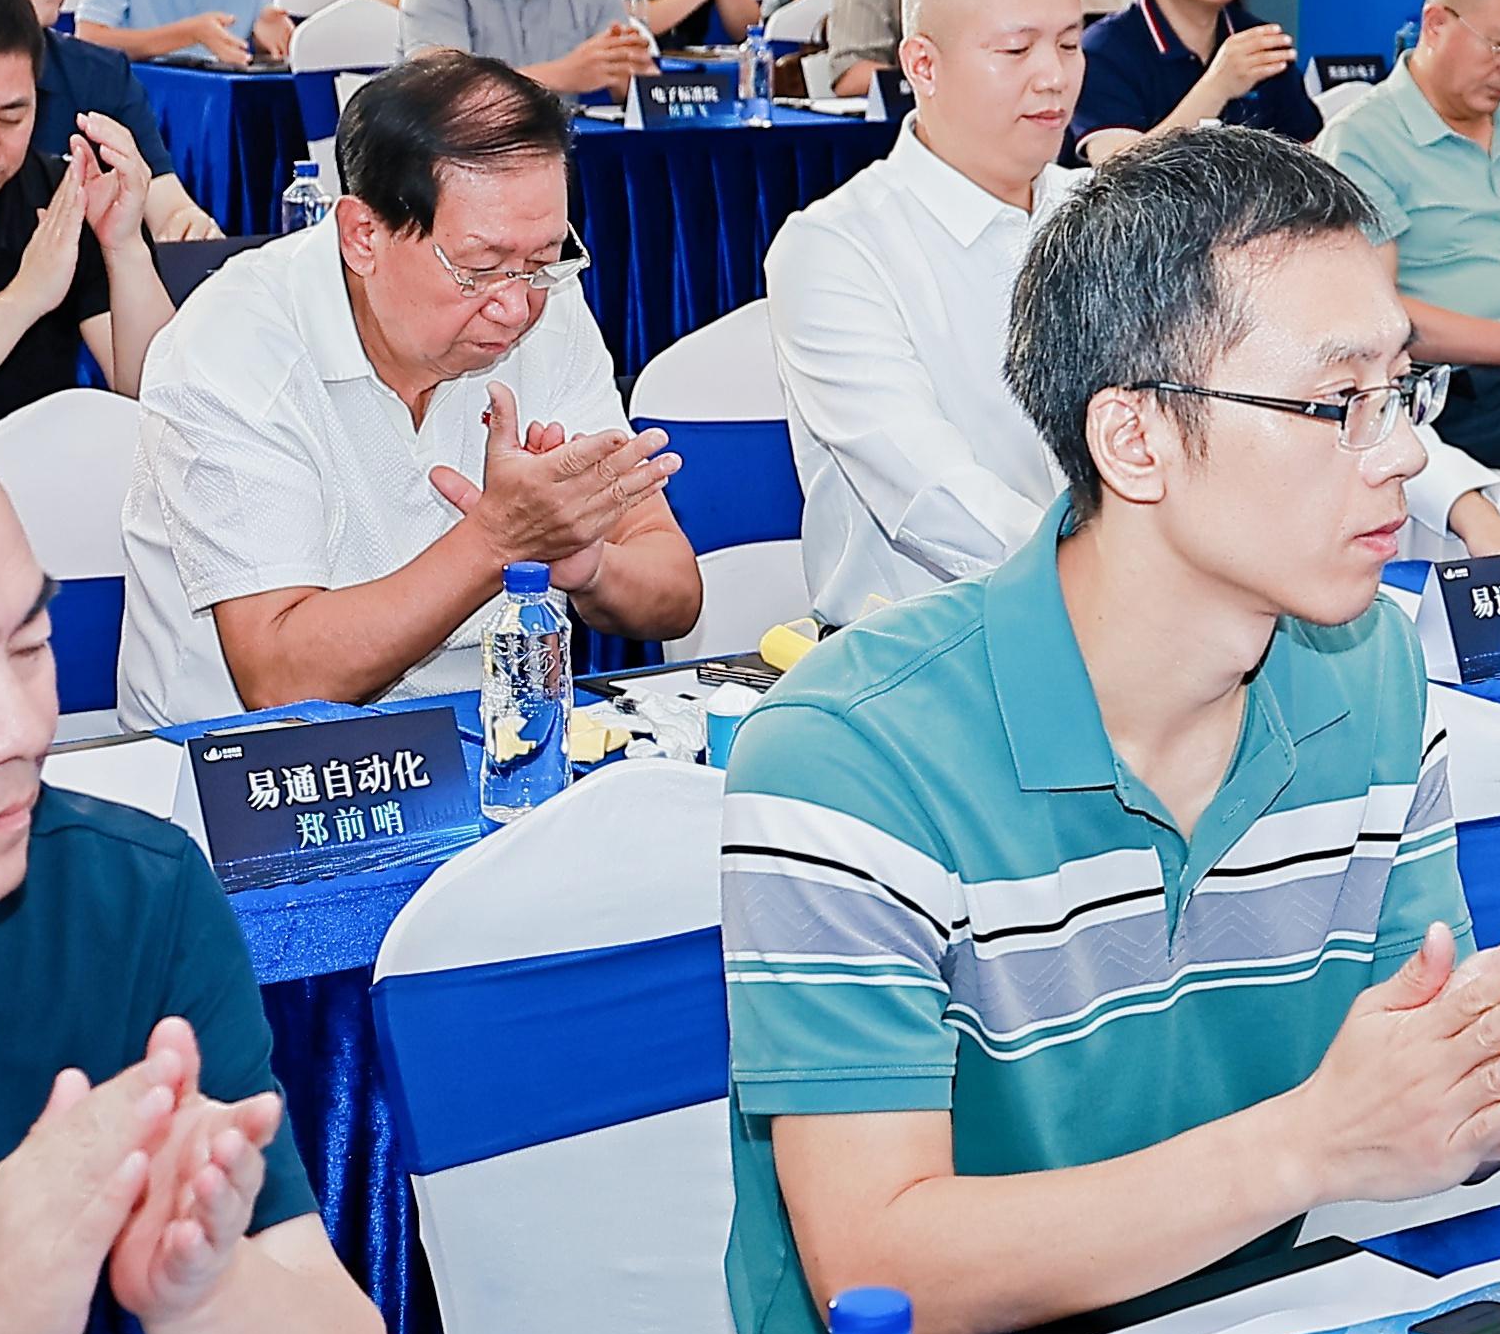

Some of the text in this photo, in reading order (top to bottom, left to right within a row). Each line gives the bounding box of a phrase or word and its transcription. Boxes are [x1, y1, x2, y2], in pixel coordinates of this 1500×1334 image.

[248, 751, 431, 811] 易通自动化
[296, 801, 404, 848] 郑前哨
